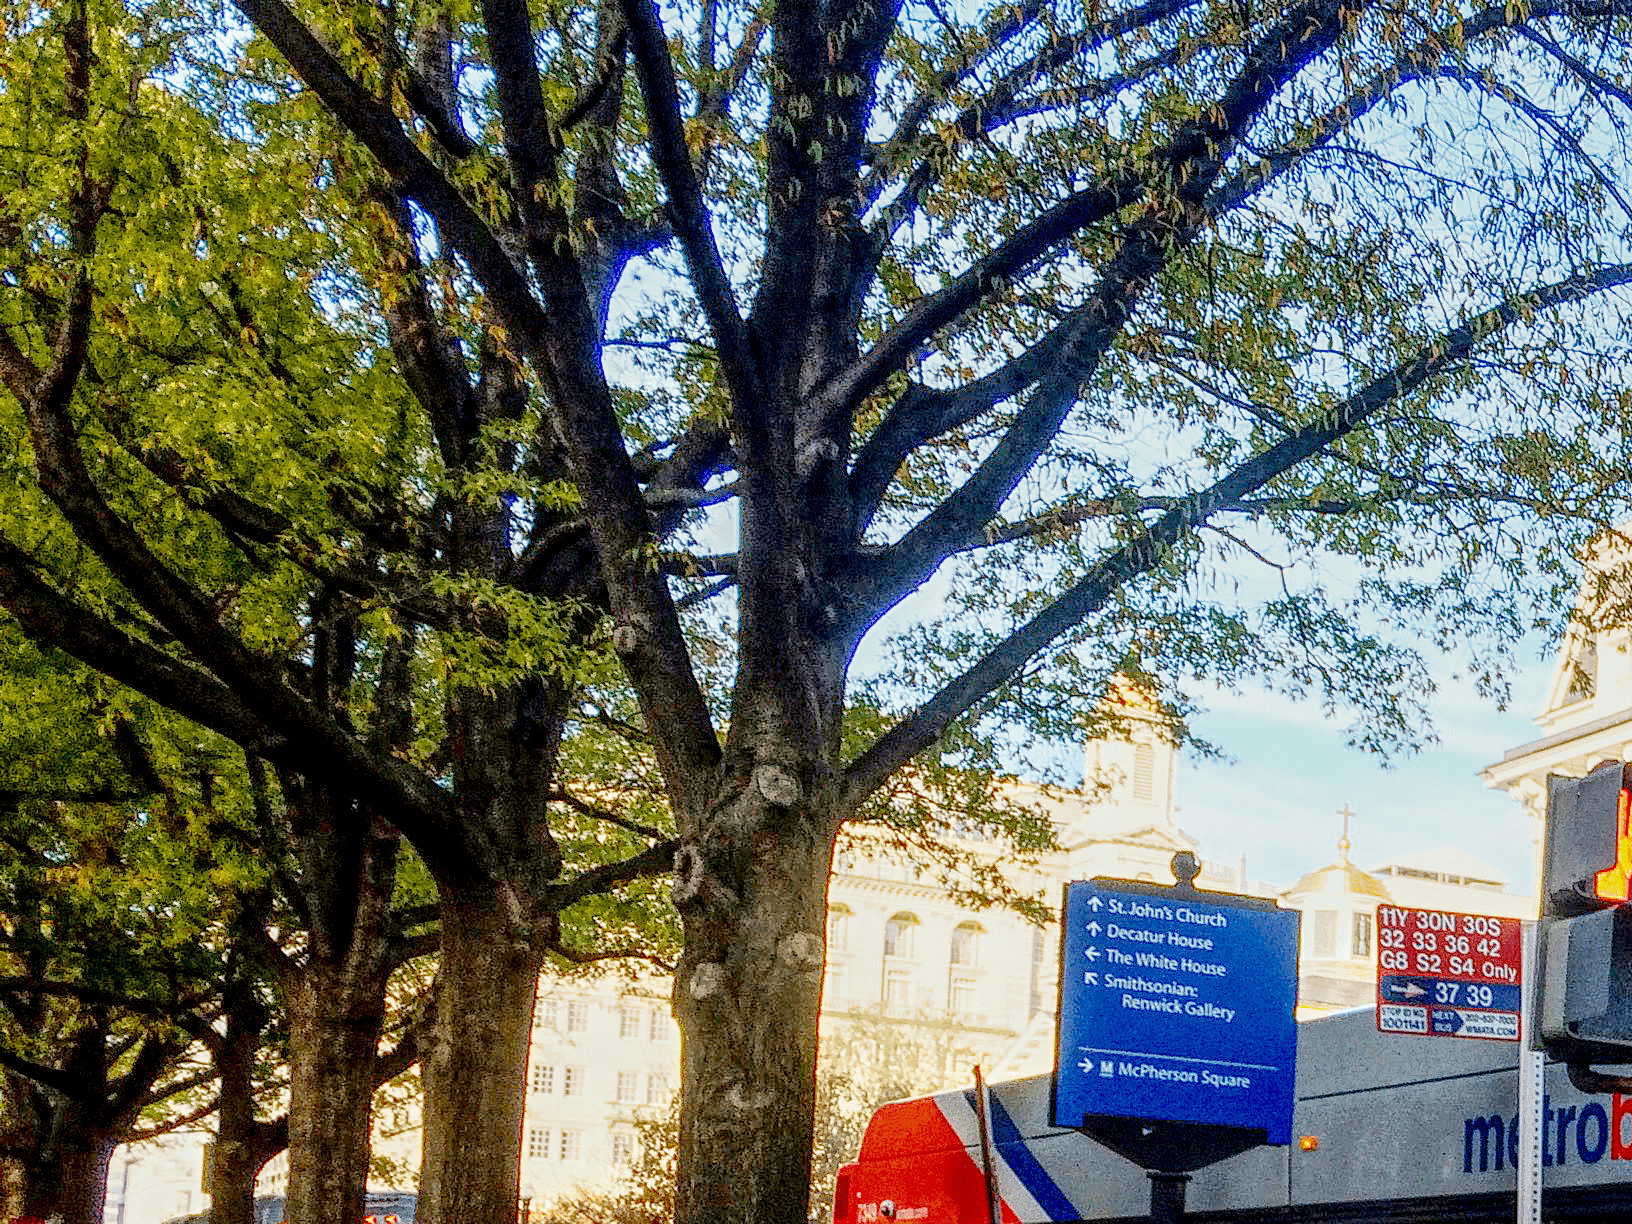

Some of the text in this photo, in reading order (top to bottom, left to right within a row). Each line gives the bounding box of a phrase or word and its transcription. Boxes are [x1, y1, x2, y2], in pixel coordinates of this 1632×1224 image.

[1129, 902, 1173, 920] John's
[1175, 907, 1227, 928] Church
[1380, 907, 1501, 937] 11Y 30N 30S
[1107, 923, 1213, 951] Decatur House
[1380, 928, 1501, 957] 32 33 36 42
[1105, 948, 1226, 977] The White House
[1380, 951, 1517, 983] G8 S2 S4 Only
[1104, 973, 1198, 998] Smithsonian:
[1435, 981, 1493, 1008] 37 39
[1122, 993, 1236, 1023] Renwick Gallery
[1118, 1062, 1199, 1084] McPherson
[1201, 1070, 1250, 1089] Square
